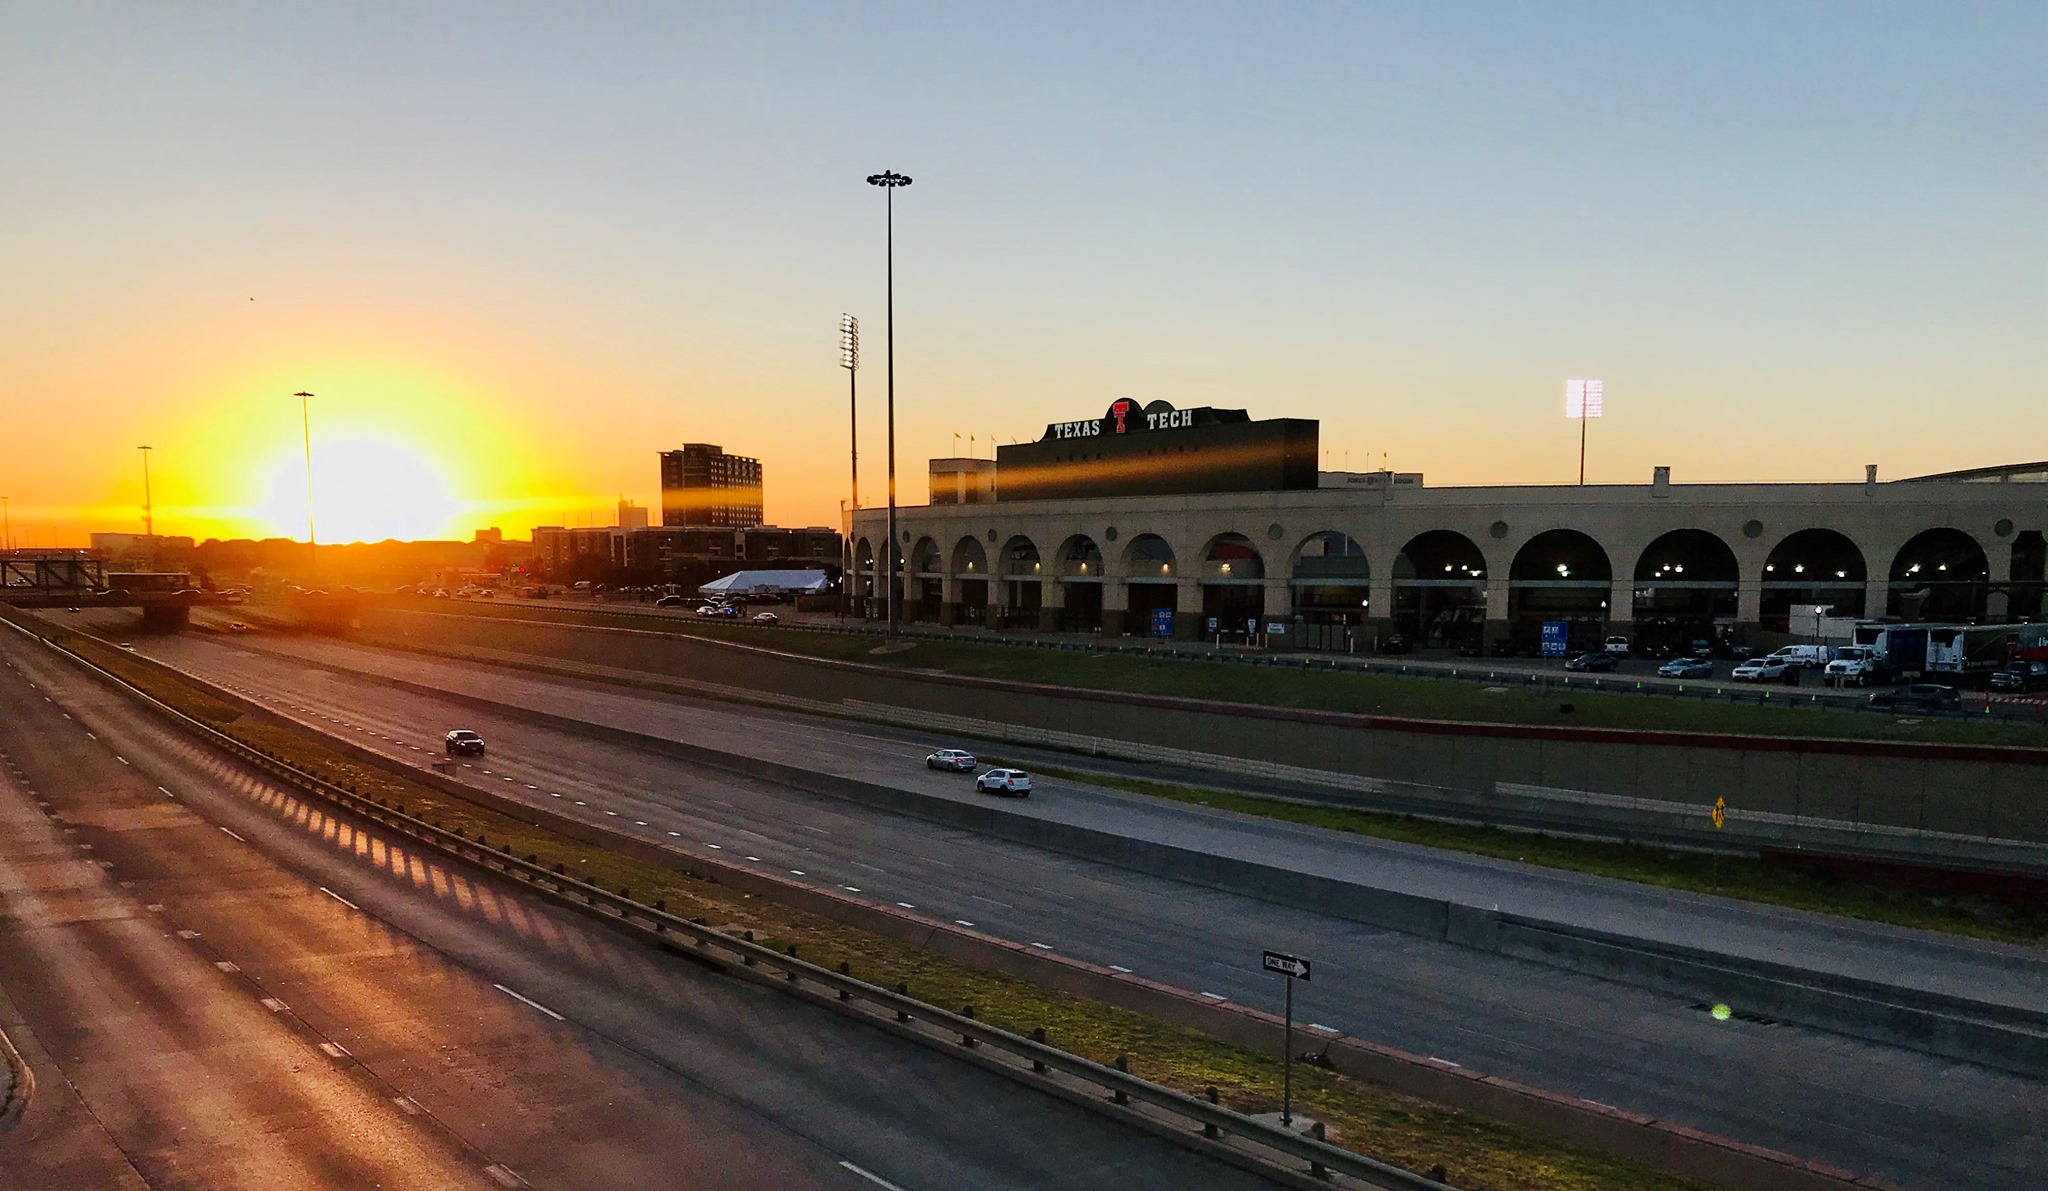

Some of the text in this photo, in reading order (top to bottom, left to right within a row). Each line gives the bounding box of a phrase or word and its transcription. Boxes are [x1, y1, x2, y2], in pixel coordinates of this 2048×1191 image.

[1054, 420, 1100, 439] TEXAS
[1147, 410, 1192, 430] TECH
[1267, 957, 1296, 971] ONE WAY
